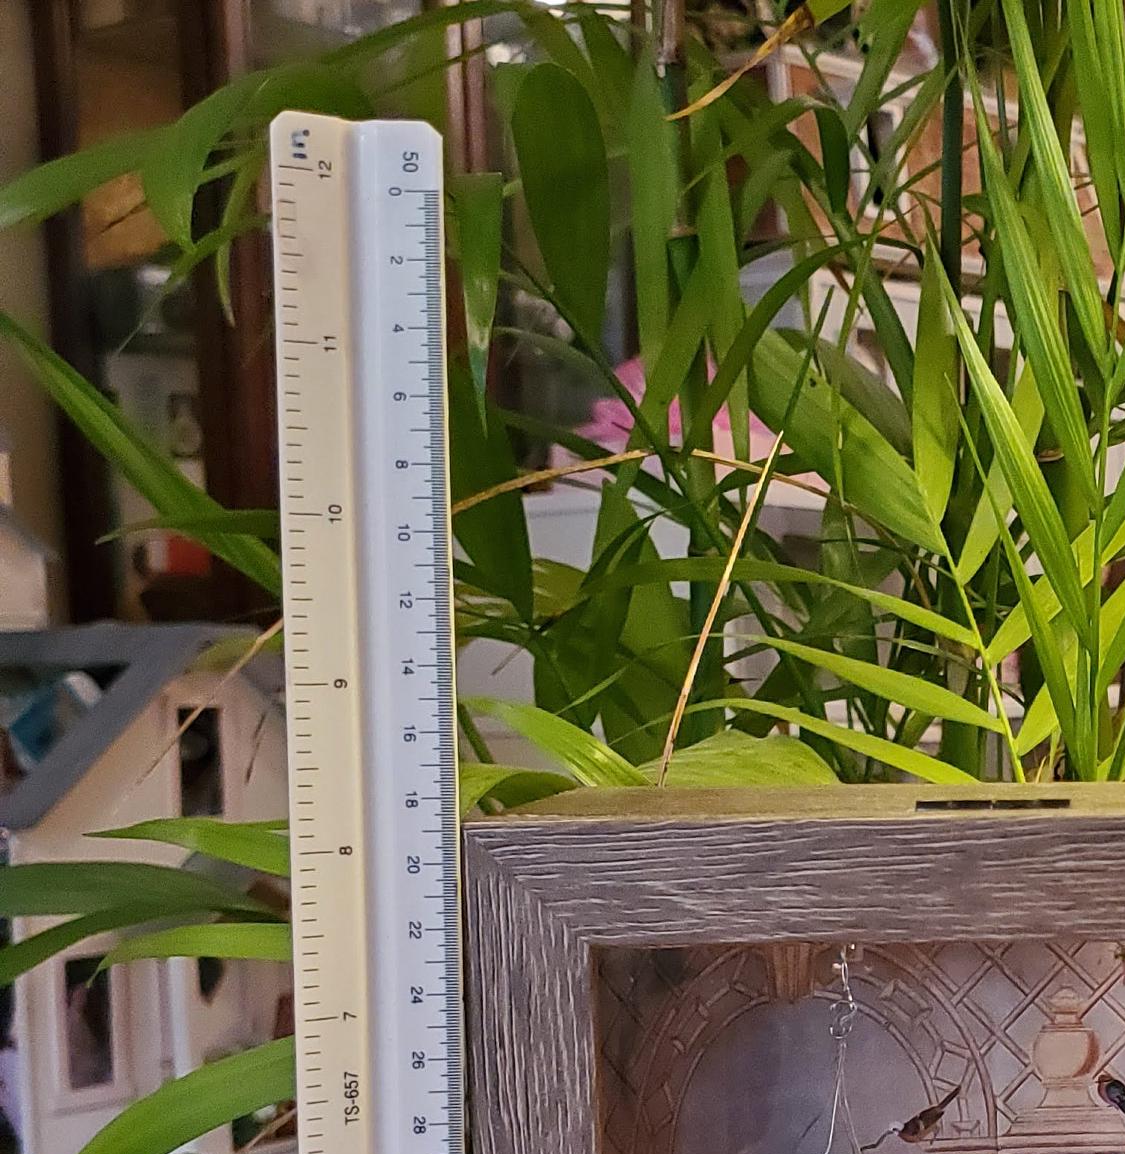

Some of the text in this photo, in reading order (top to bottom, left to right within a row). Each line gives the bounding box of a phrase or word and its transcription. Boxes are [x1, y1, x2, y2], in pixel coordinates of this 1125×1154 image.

[318, 160, 332, 179] 12
[402, 151, 419, 173] 50
[390, 255, 403, 265] 2
[392, 323, 404, 333] 4
[323, 335, 337, 352] 11
[395, 459, 408, 469] 8
[328, 504, 342, 523] 10
[397, 523, 410, 542] 10
[400, 591, 413, 609] 12
[401, 658, 414, 676] 14
[403, 725, 416, 742] 16
[405, 791, 418, 808] 18
[339, 845, 352, 855] 8
[407, 855, 420, 874] 20
[409, 921, 422, 940] 22
[410, 986, 423, 1004] 24
[343, 1011, 357, 1021] 7
[412, 1050, 425, 1070] 26
[344, 1071, 360, 1125] TS-657
[413, 1116, 426, 1135] 28
